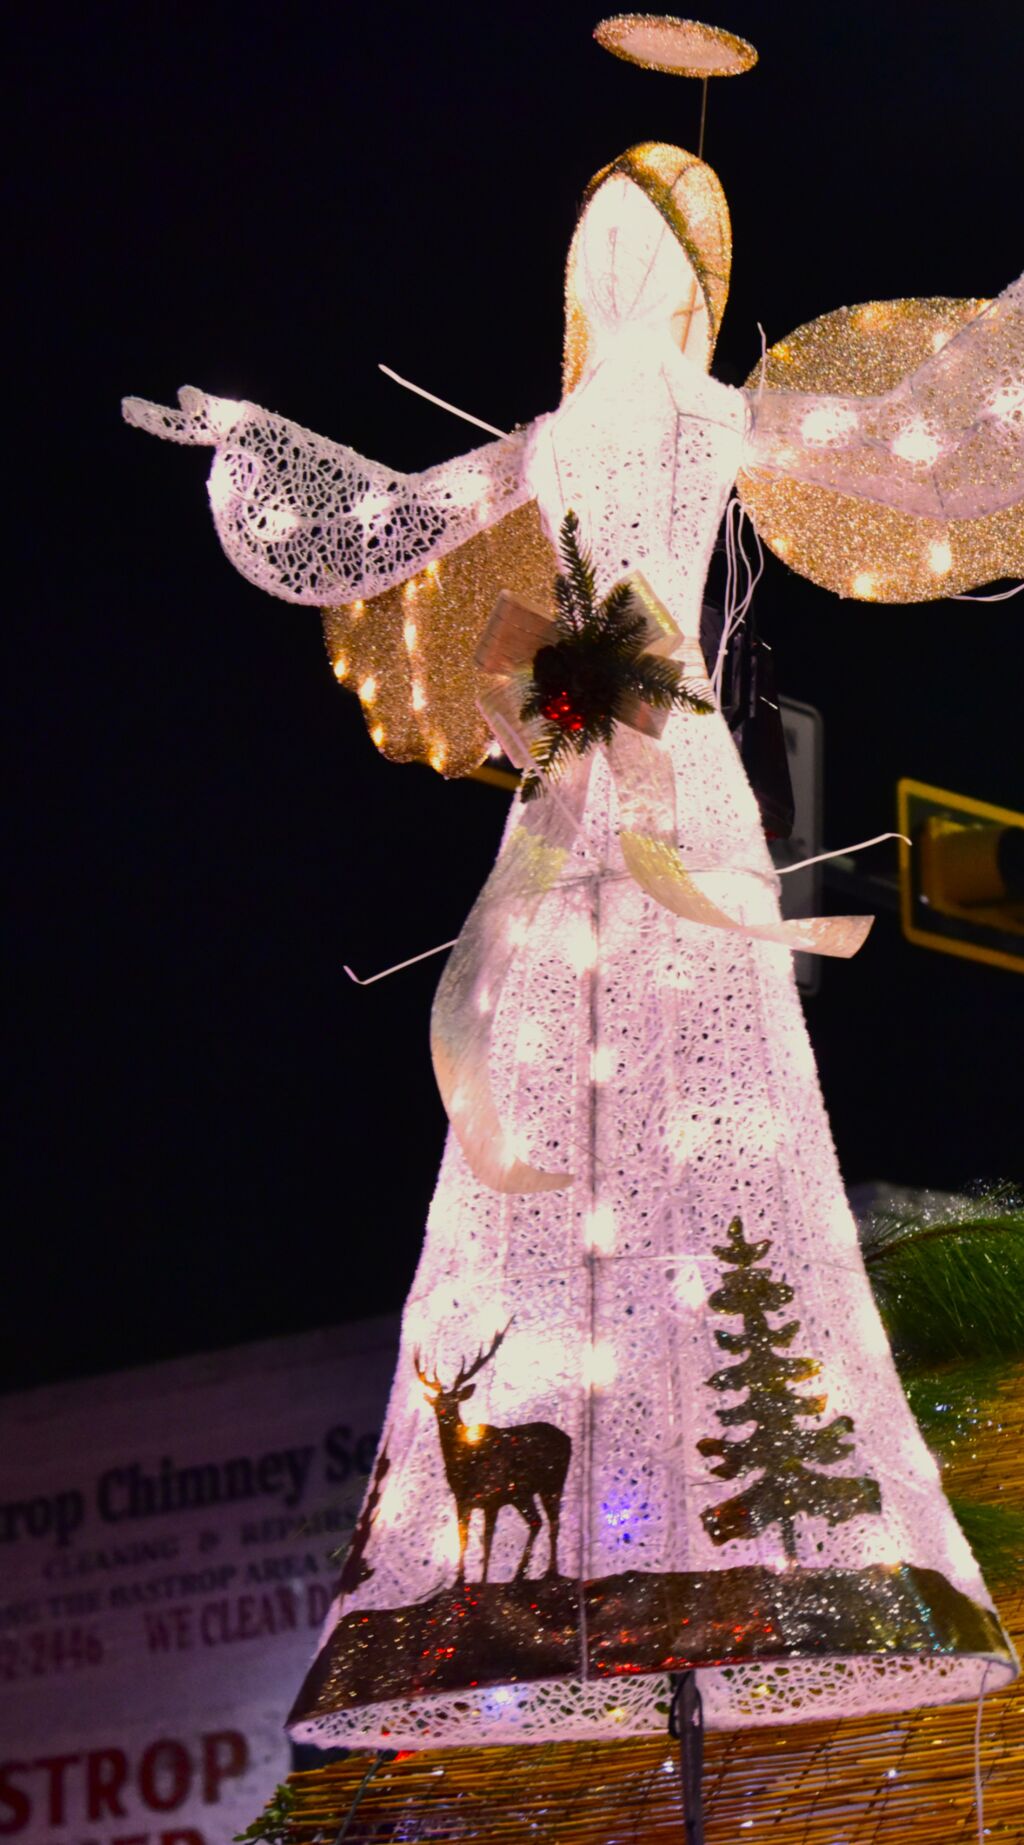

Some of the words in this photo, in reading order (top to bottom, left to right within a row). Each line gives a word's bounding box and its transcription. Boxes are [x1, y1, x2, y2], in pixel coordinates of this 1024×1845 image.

[97, 1445, 316, 1523] Chimney
[143, 1605, 193, 1653] WE
[202, 1584, 298, 1646] CLEAN
